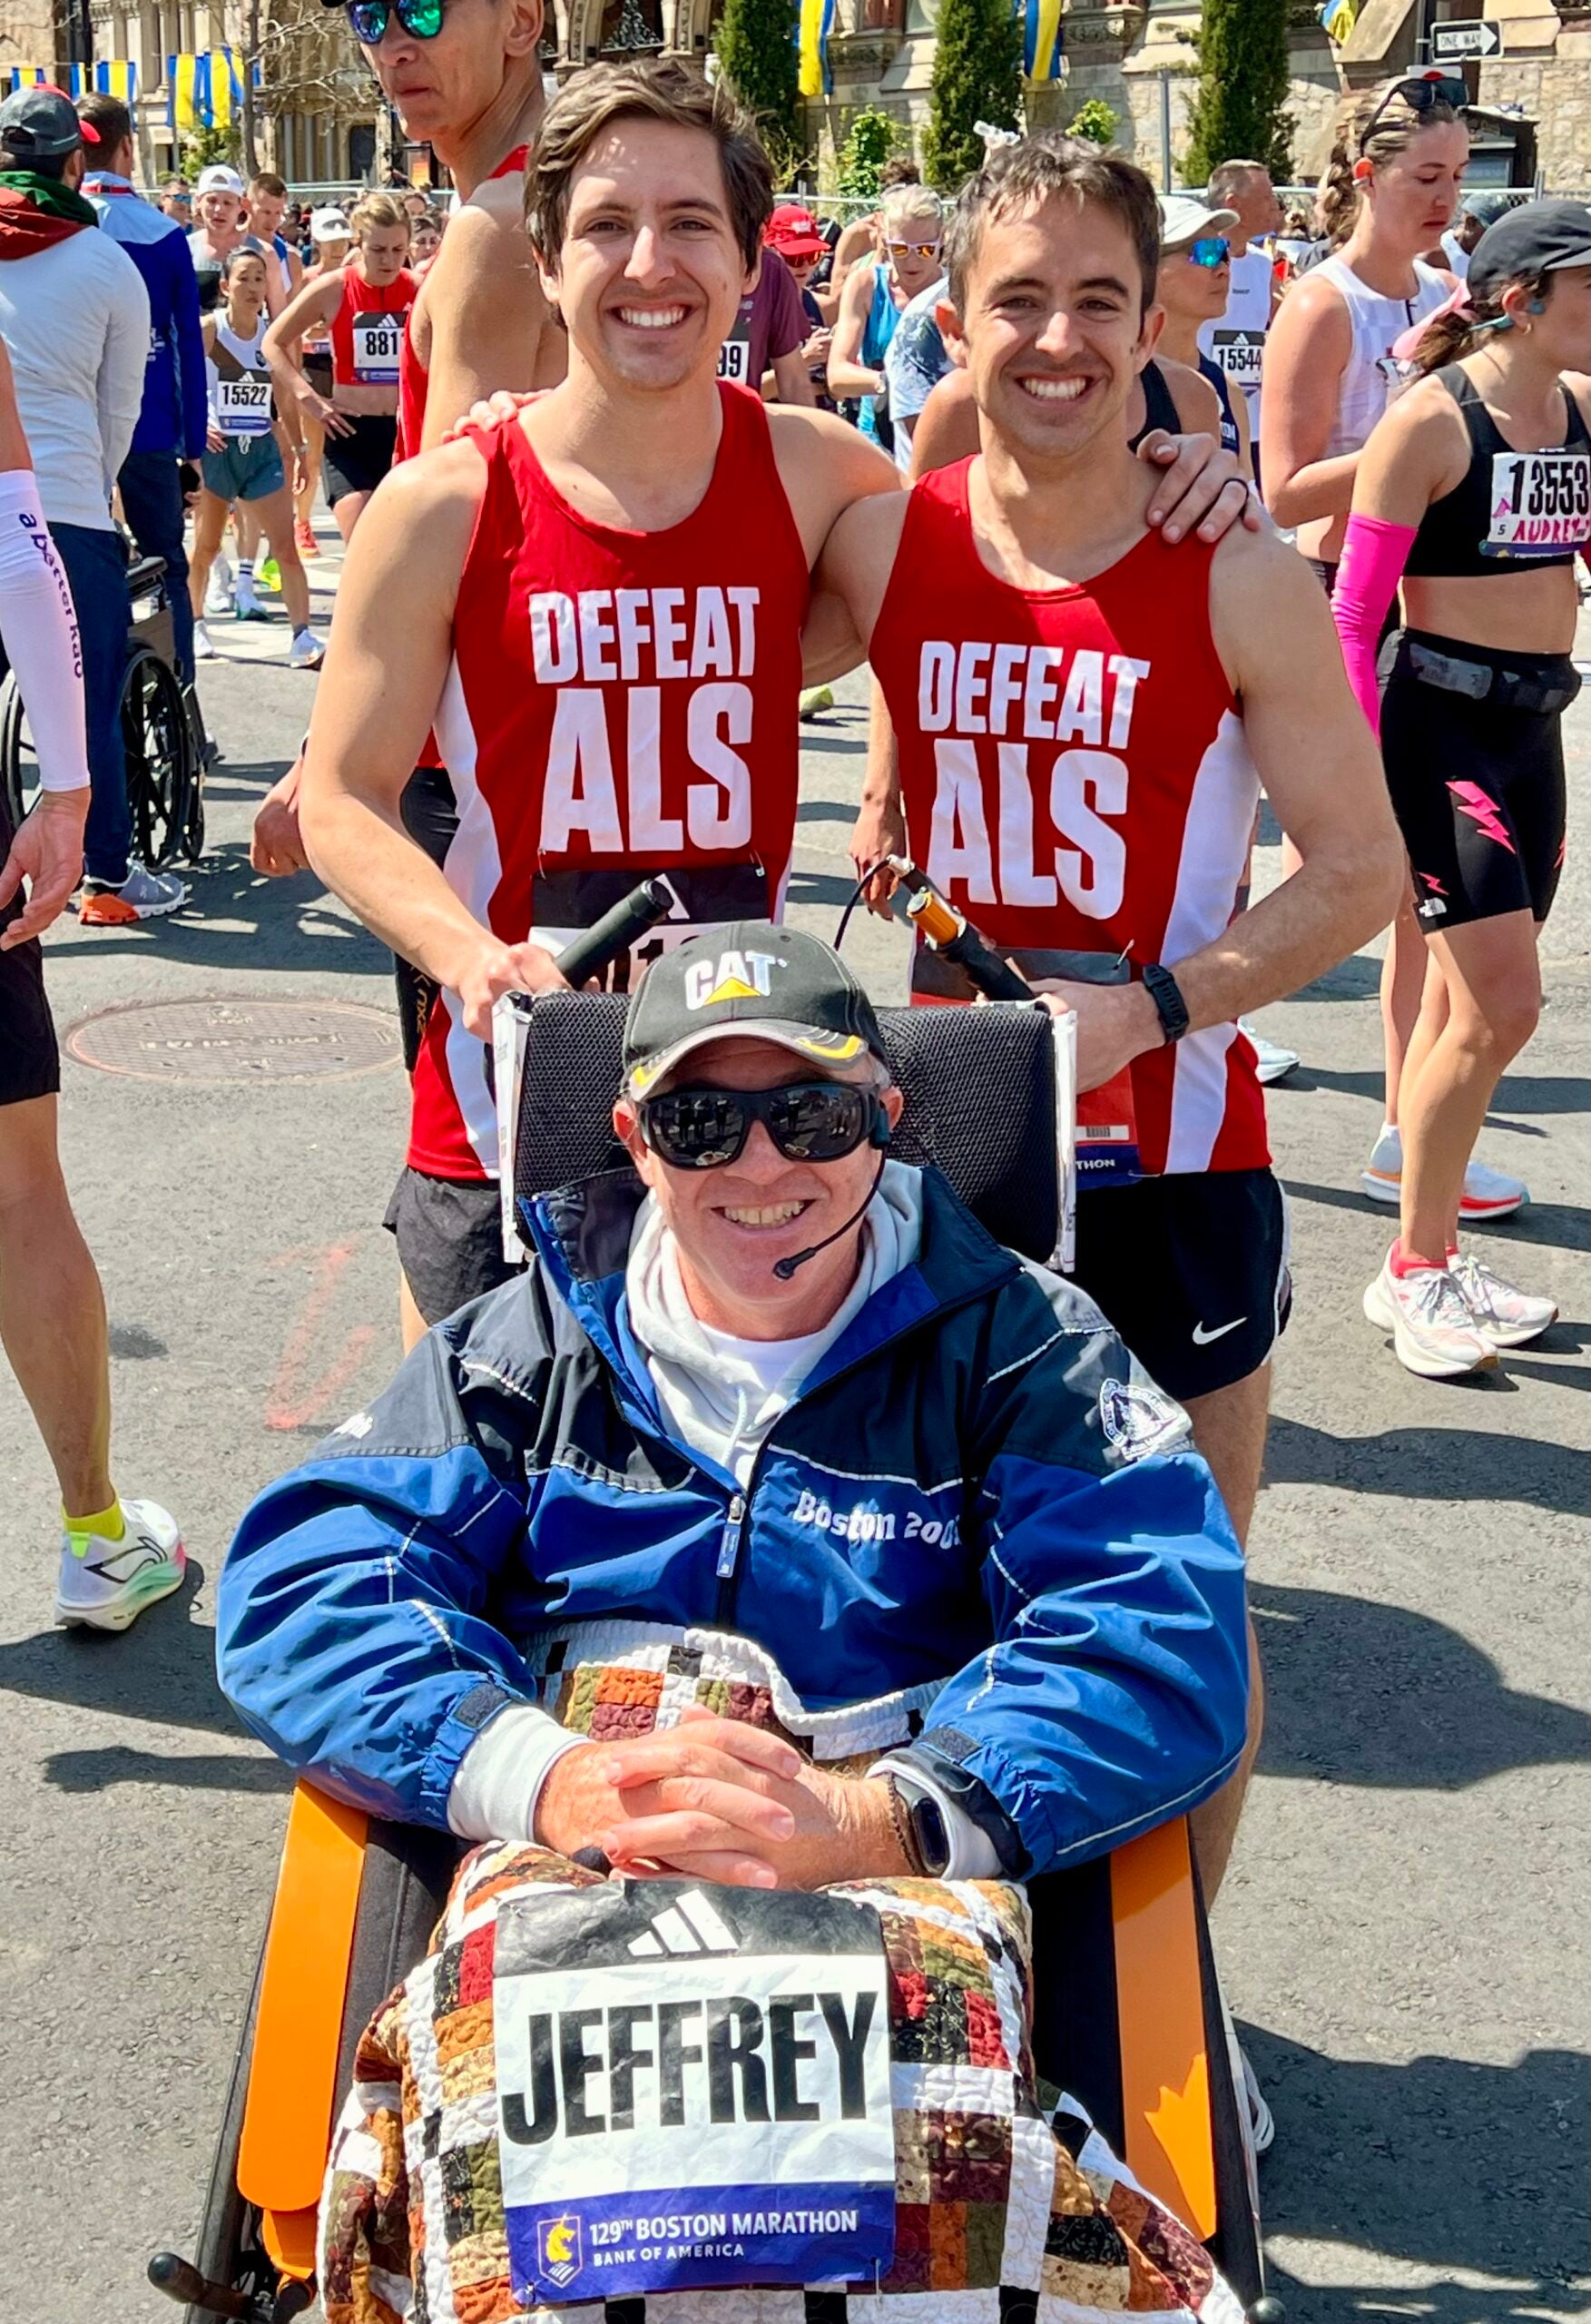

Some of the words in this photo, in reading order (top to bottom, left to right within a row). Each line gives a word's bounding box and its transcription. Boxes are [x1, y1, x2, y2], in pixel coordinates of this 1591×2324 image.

[1440, 34, 1458, 47] ONE
[1464, 34, 1481, 44] WAY
[365, 331, 404, 356] 881
[1218, 348, 1262, 371] 15544
[222, 385, 267, 407] 15522
[1508, 459, 1589, 516] 13553
[19, 513, 37, 528] a
[1512, 518, 1580, 543] AUDREY
[528, 586, 761, 684] DEFEAT
[918, 641, 1151, 750] DEFEAT
[540, 682, 753, 852] ALS
[927, 739, 1128, 921] ALS
[684, 950, 776, 1011] CAT
[1075, 1158, 1115, 1170] THON
[792, 1490, 896, 1541] Boston
[501, 1992, 879, 2146] JEFFREY
[590, 2219, 633, 2246] 129TH
[637, 2214, 726, 2240] BOSTON
[732, 2210, 859, 2236] MARATHON
[594, 2250, 635, 2267] BANK
[640, 2247, 662, 2260] OF
[666, 2243, 745, 2259] AMERICA
